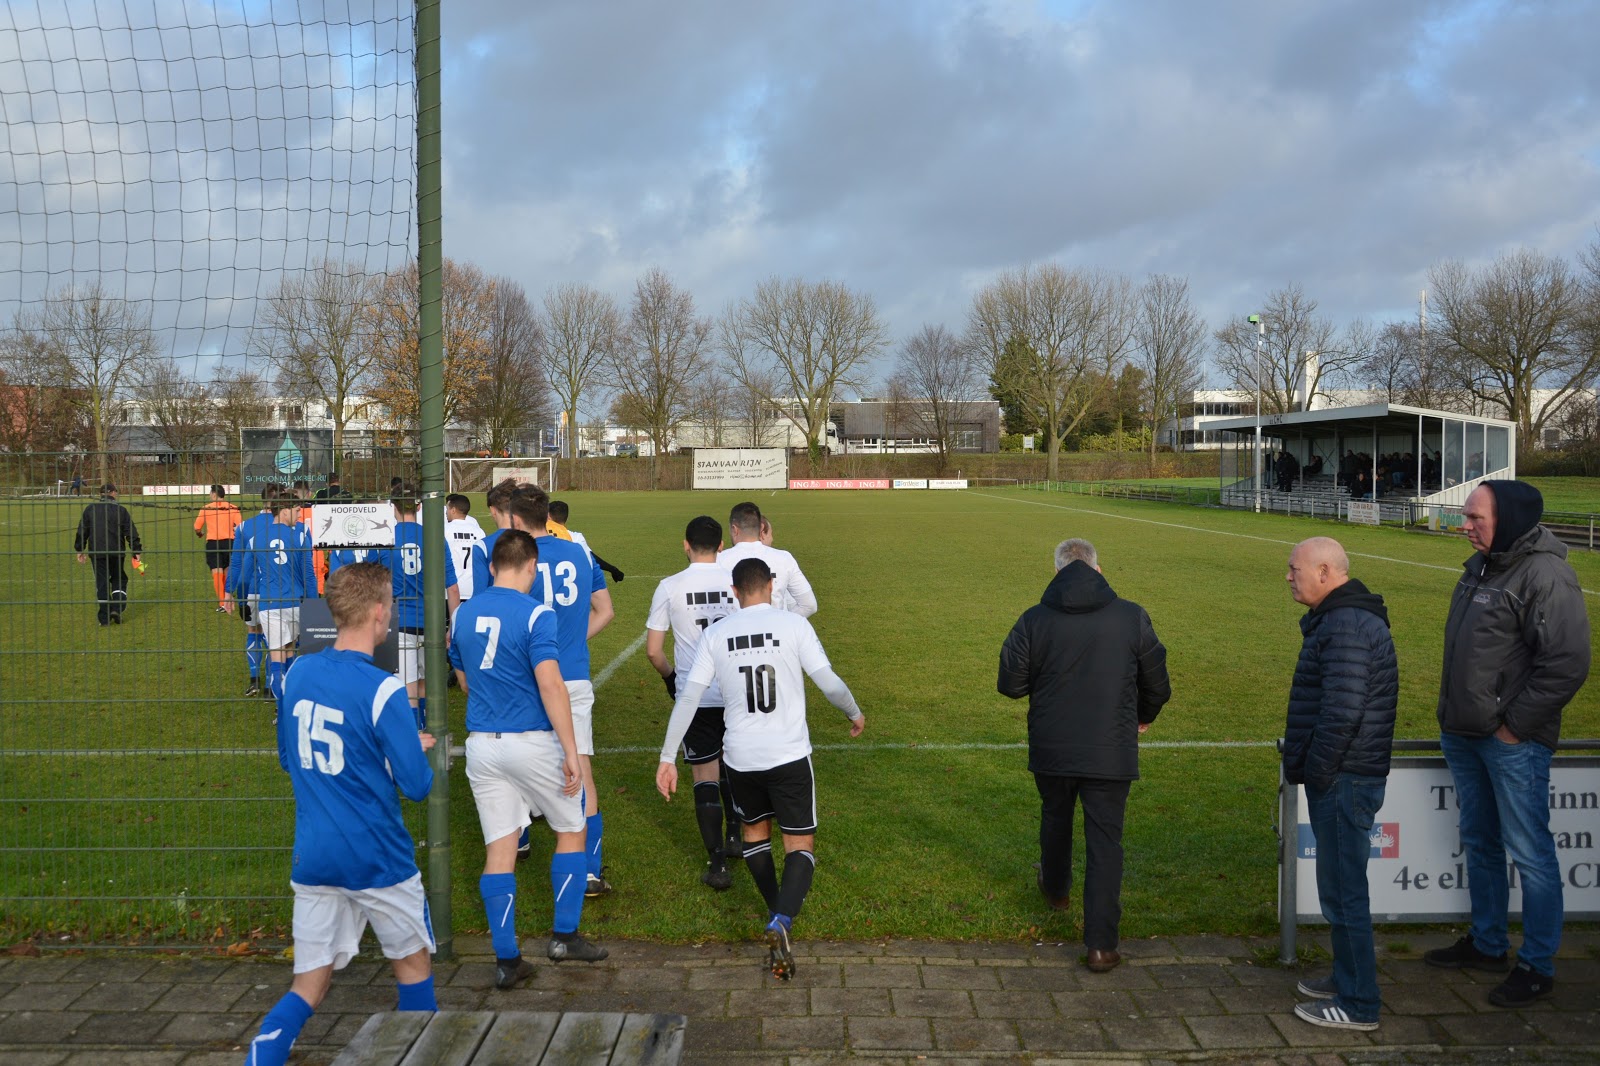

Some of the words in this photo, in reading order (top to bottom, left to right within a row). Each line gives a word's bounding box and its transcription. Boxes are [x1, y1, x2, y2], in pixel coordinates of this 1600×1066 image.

[697, 460, 718, 468] STAN
[740, 459, 762, 467] RIJN
[793, 481, 809, 489] ING
[331, 506, 377, 514] HOOFDVELD
[269, 538, 288, 565] 3
[401, 543, 422, 575] 8
[462, 547, 471, 569] 7
[537, 560, 578, 608] 13
[475, 616, 501, 670] 7
[739, 664, 777, 713] 10
[292, 699, 345, 776] 15
[1549, 785, 1599, 809] inn
[1305, 847, 1316, 856] BE
[1550, 831, 1593, 850] an
[1393, 865, 1429, 891] 4e
